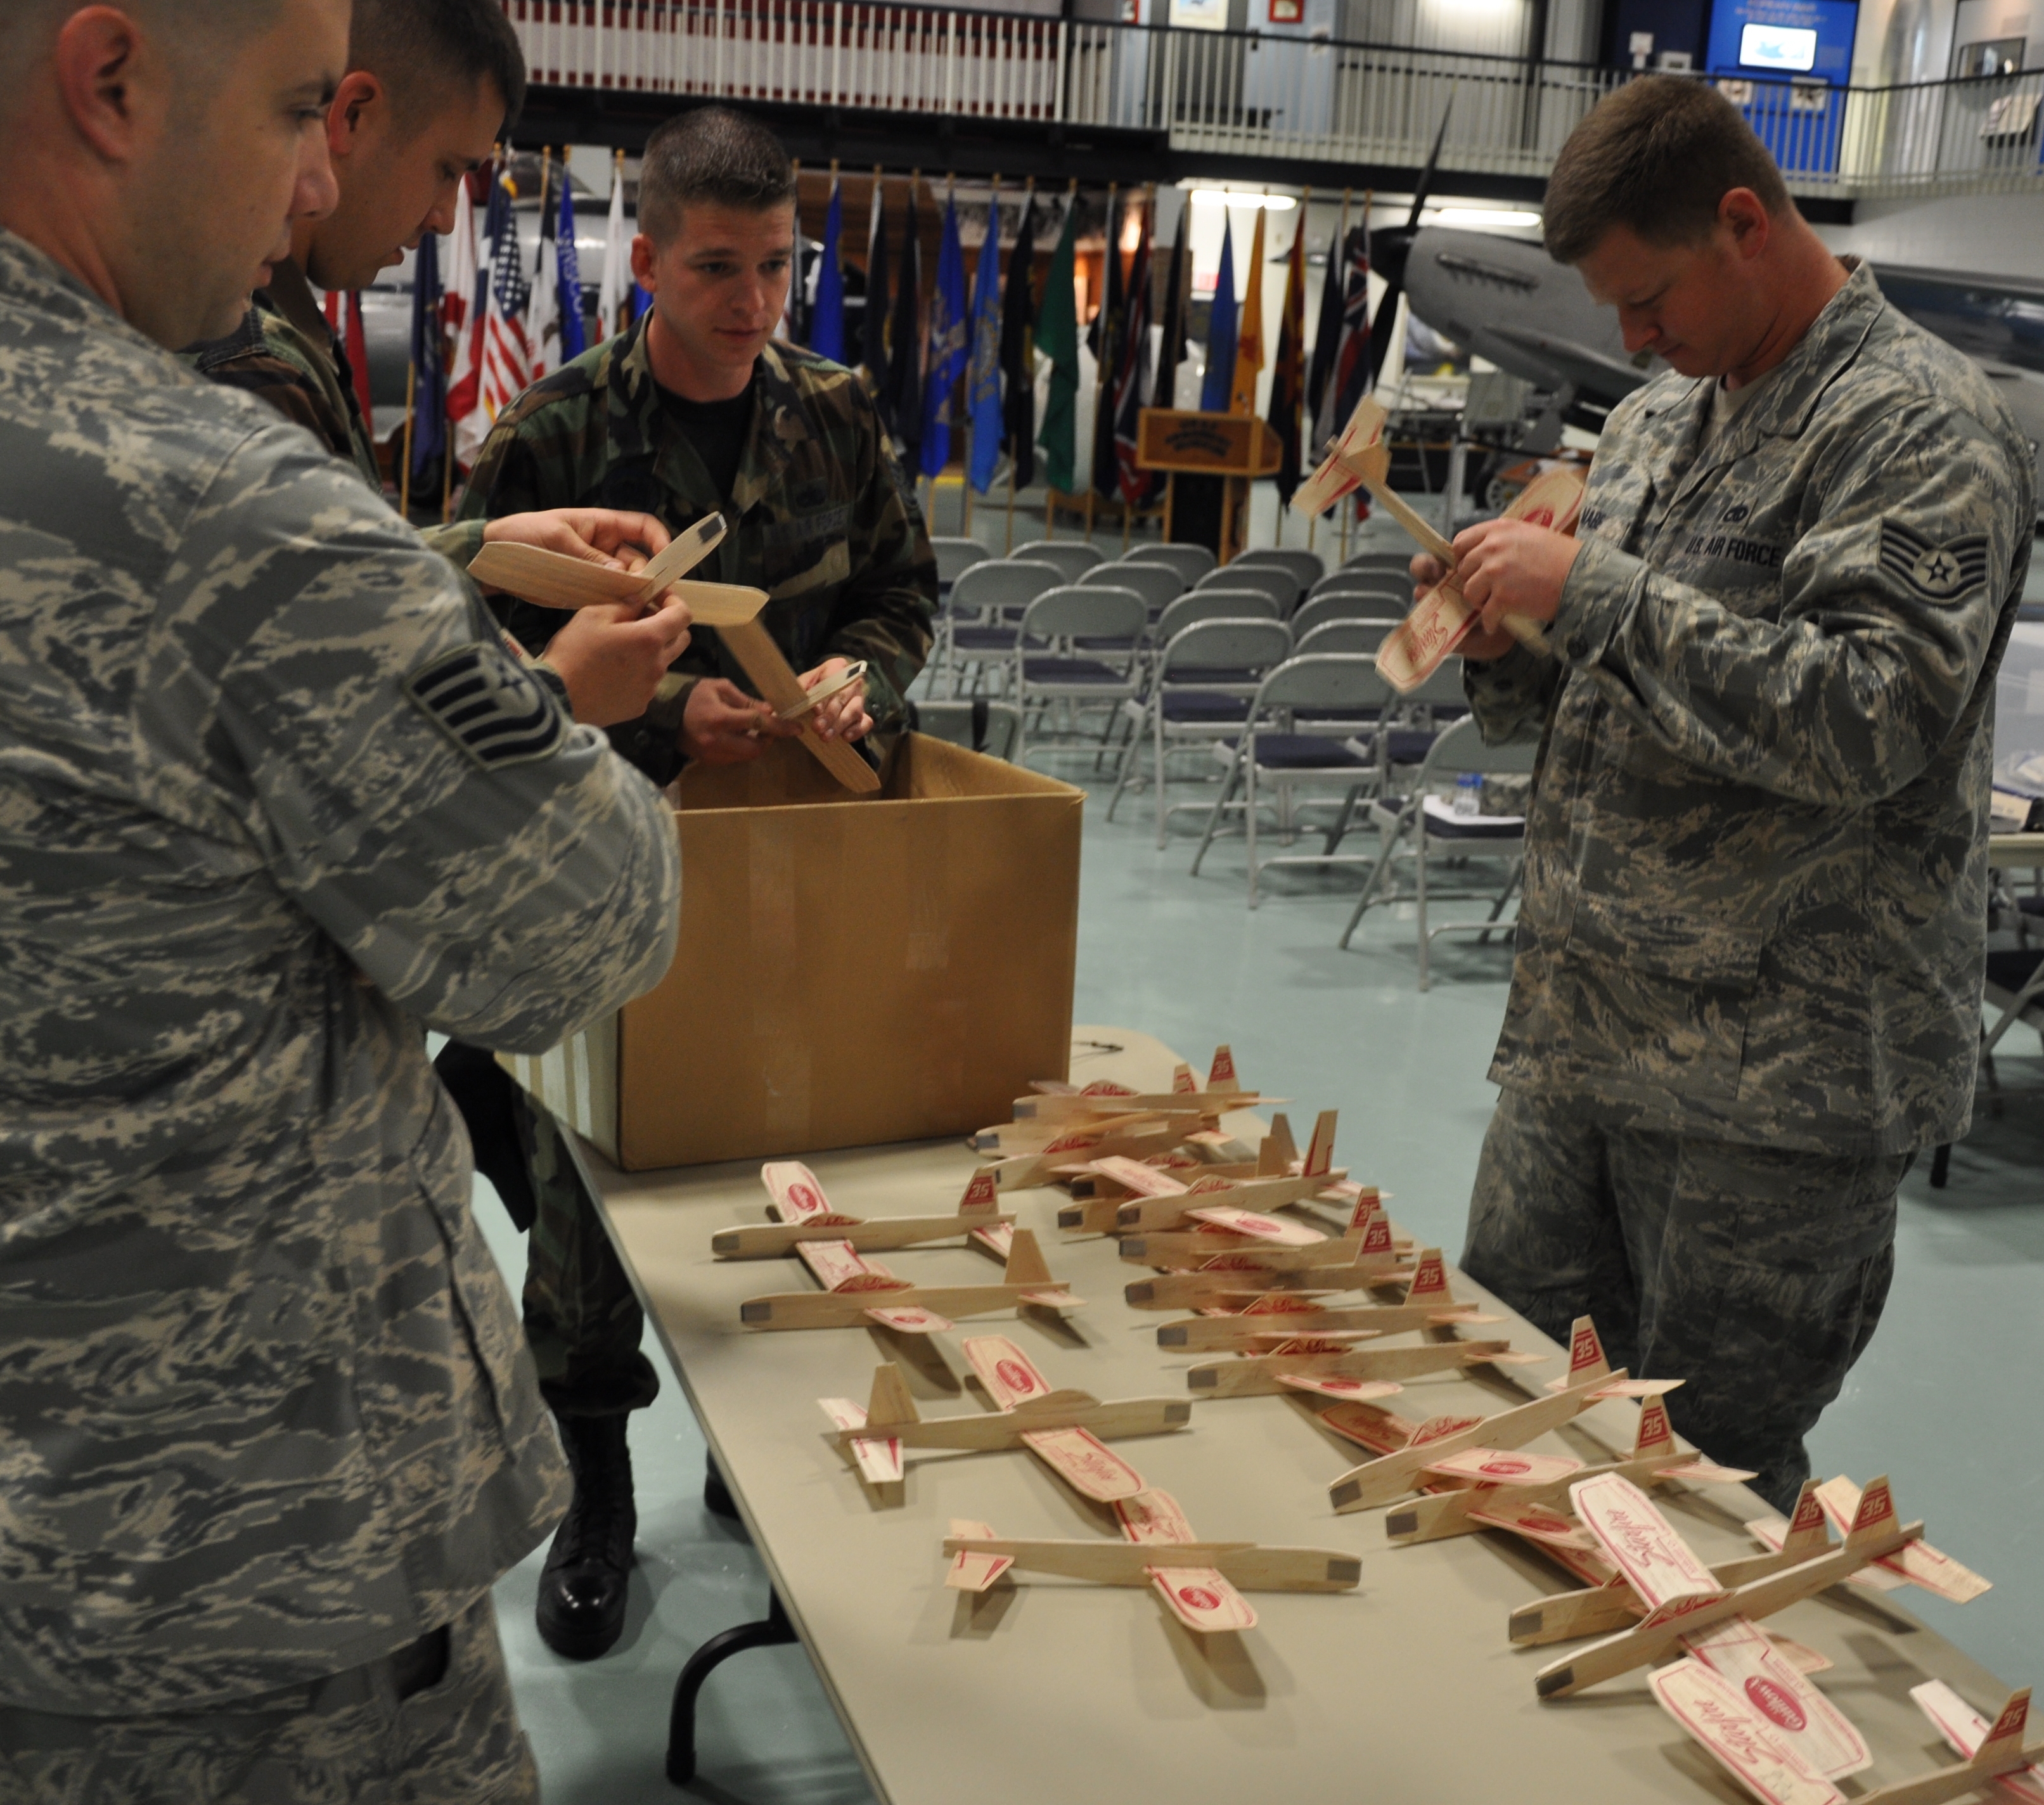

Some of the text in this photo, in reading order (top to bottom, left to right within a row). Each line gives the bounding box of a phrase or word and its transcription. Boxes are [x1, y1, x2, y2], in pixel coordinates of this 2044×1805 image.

[1685, 534, 1781, 568] U.S. AIR FORCE
[1213, 1059, 1231, 1076] 35
[969, 1183, 991, 1200] 35
[1367, 1228, 1389, 1247] 35
[1418, 1267, 1441, 1287] 35
[1575, 1335, 1595, 1361] 35
[1643, 1414, 1664, 1439] 35
[1798, 1500, 1820, 1522] 35
[1861, 1493, 1888, 1521] 35
[1996, 1705, 2028, 1732] 35
